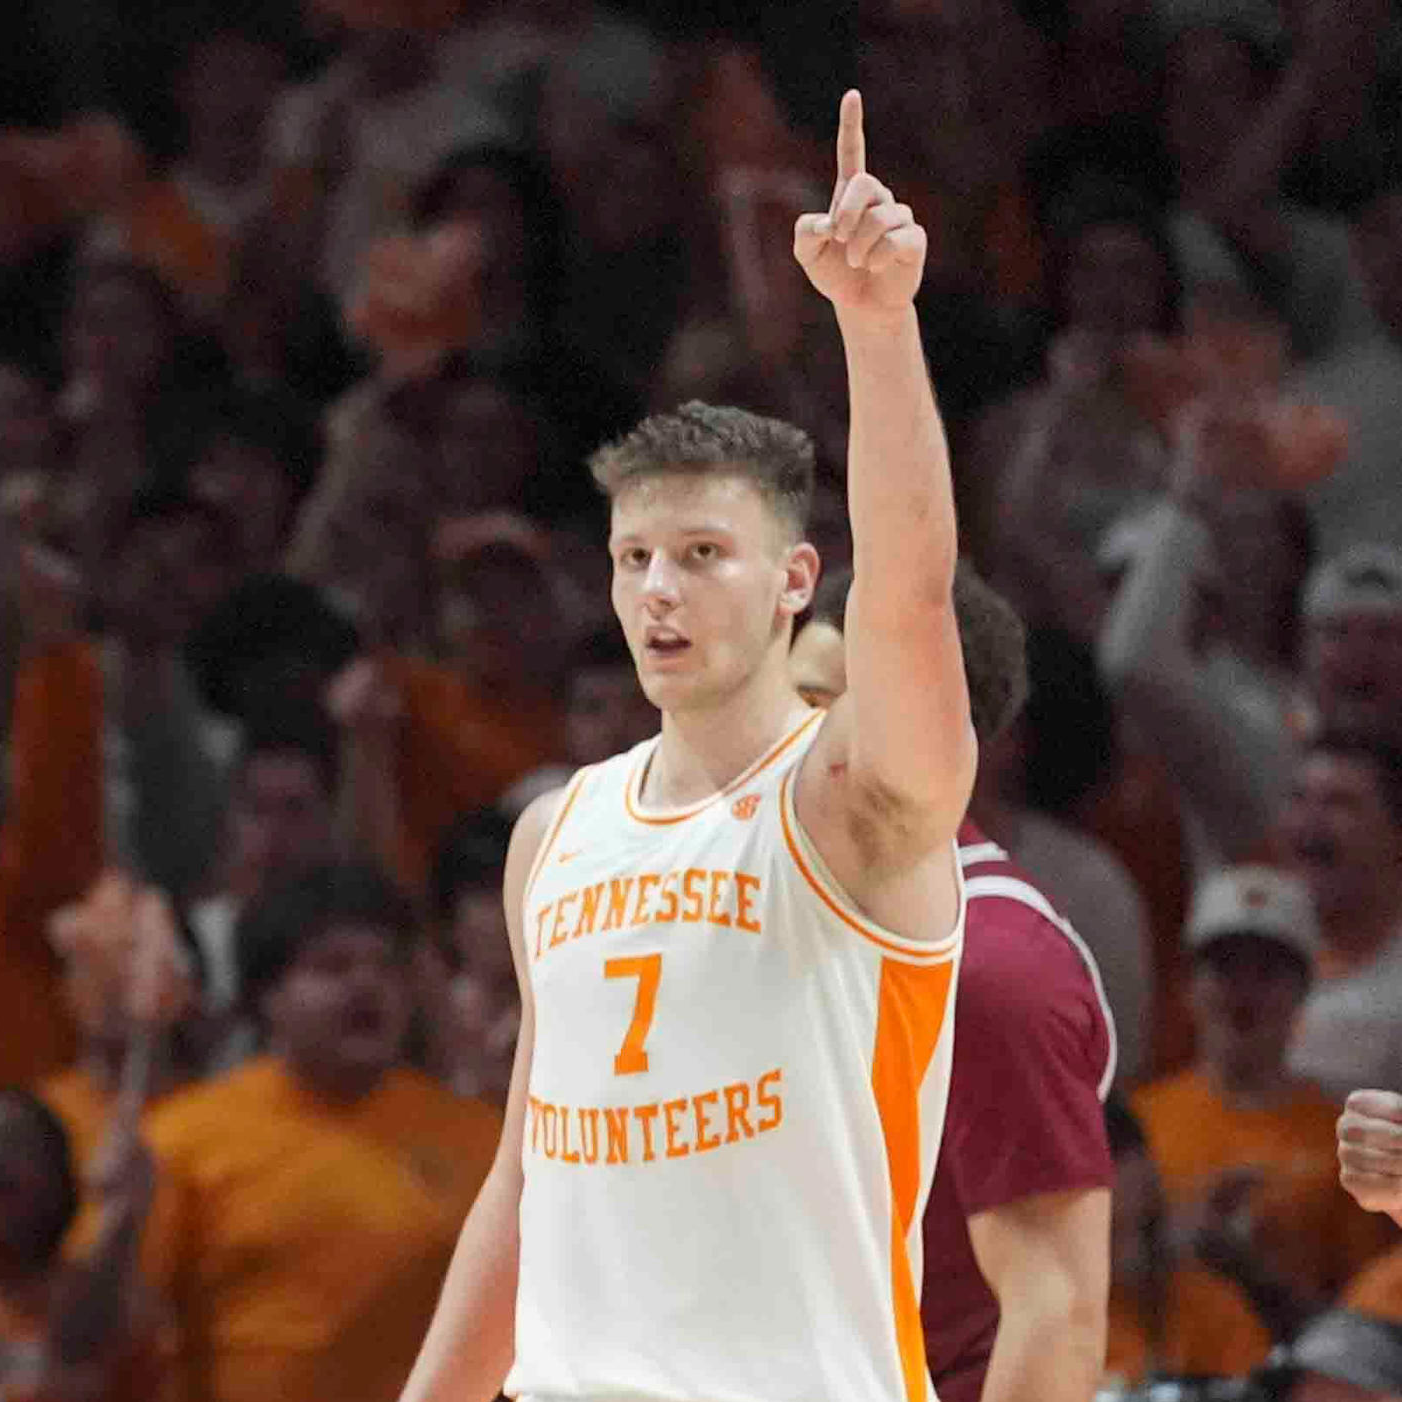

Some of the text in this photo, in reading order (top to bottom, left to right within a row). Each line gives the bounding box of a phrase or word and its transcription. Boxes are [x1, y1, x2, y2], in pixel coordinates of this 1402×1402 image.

[535, 868, 761, 960] TENNESSEE
[604, 953, 662, 1076] 7
[528, 1068, 783, 1166] VOLUNTEERS
